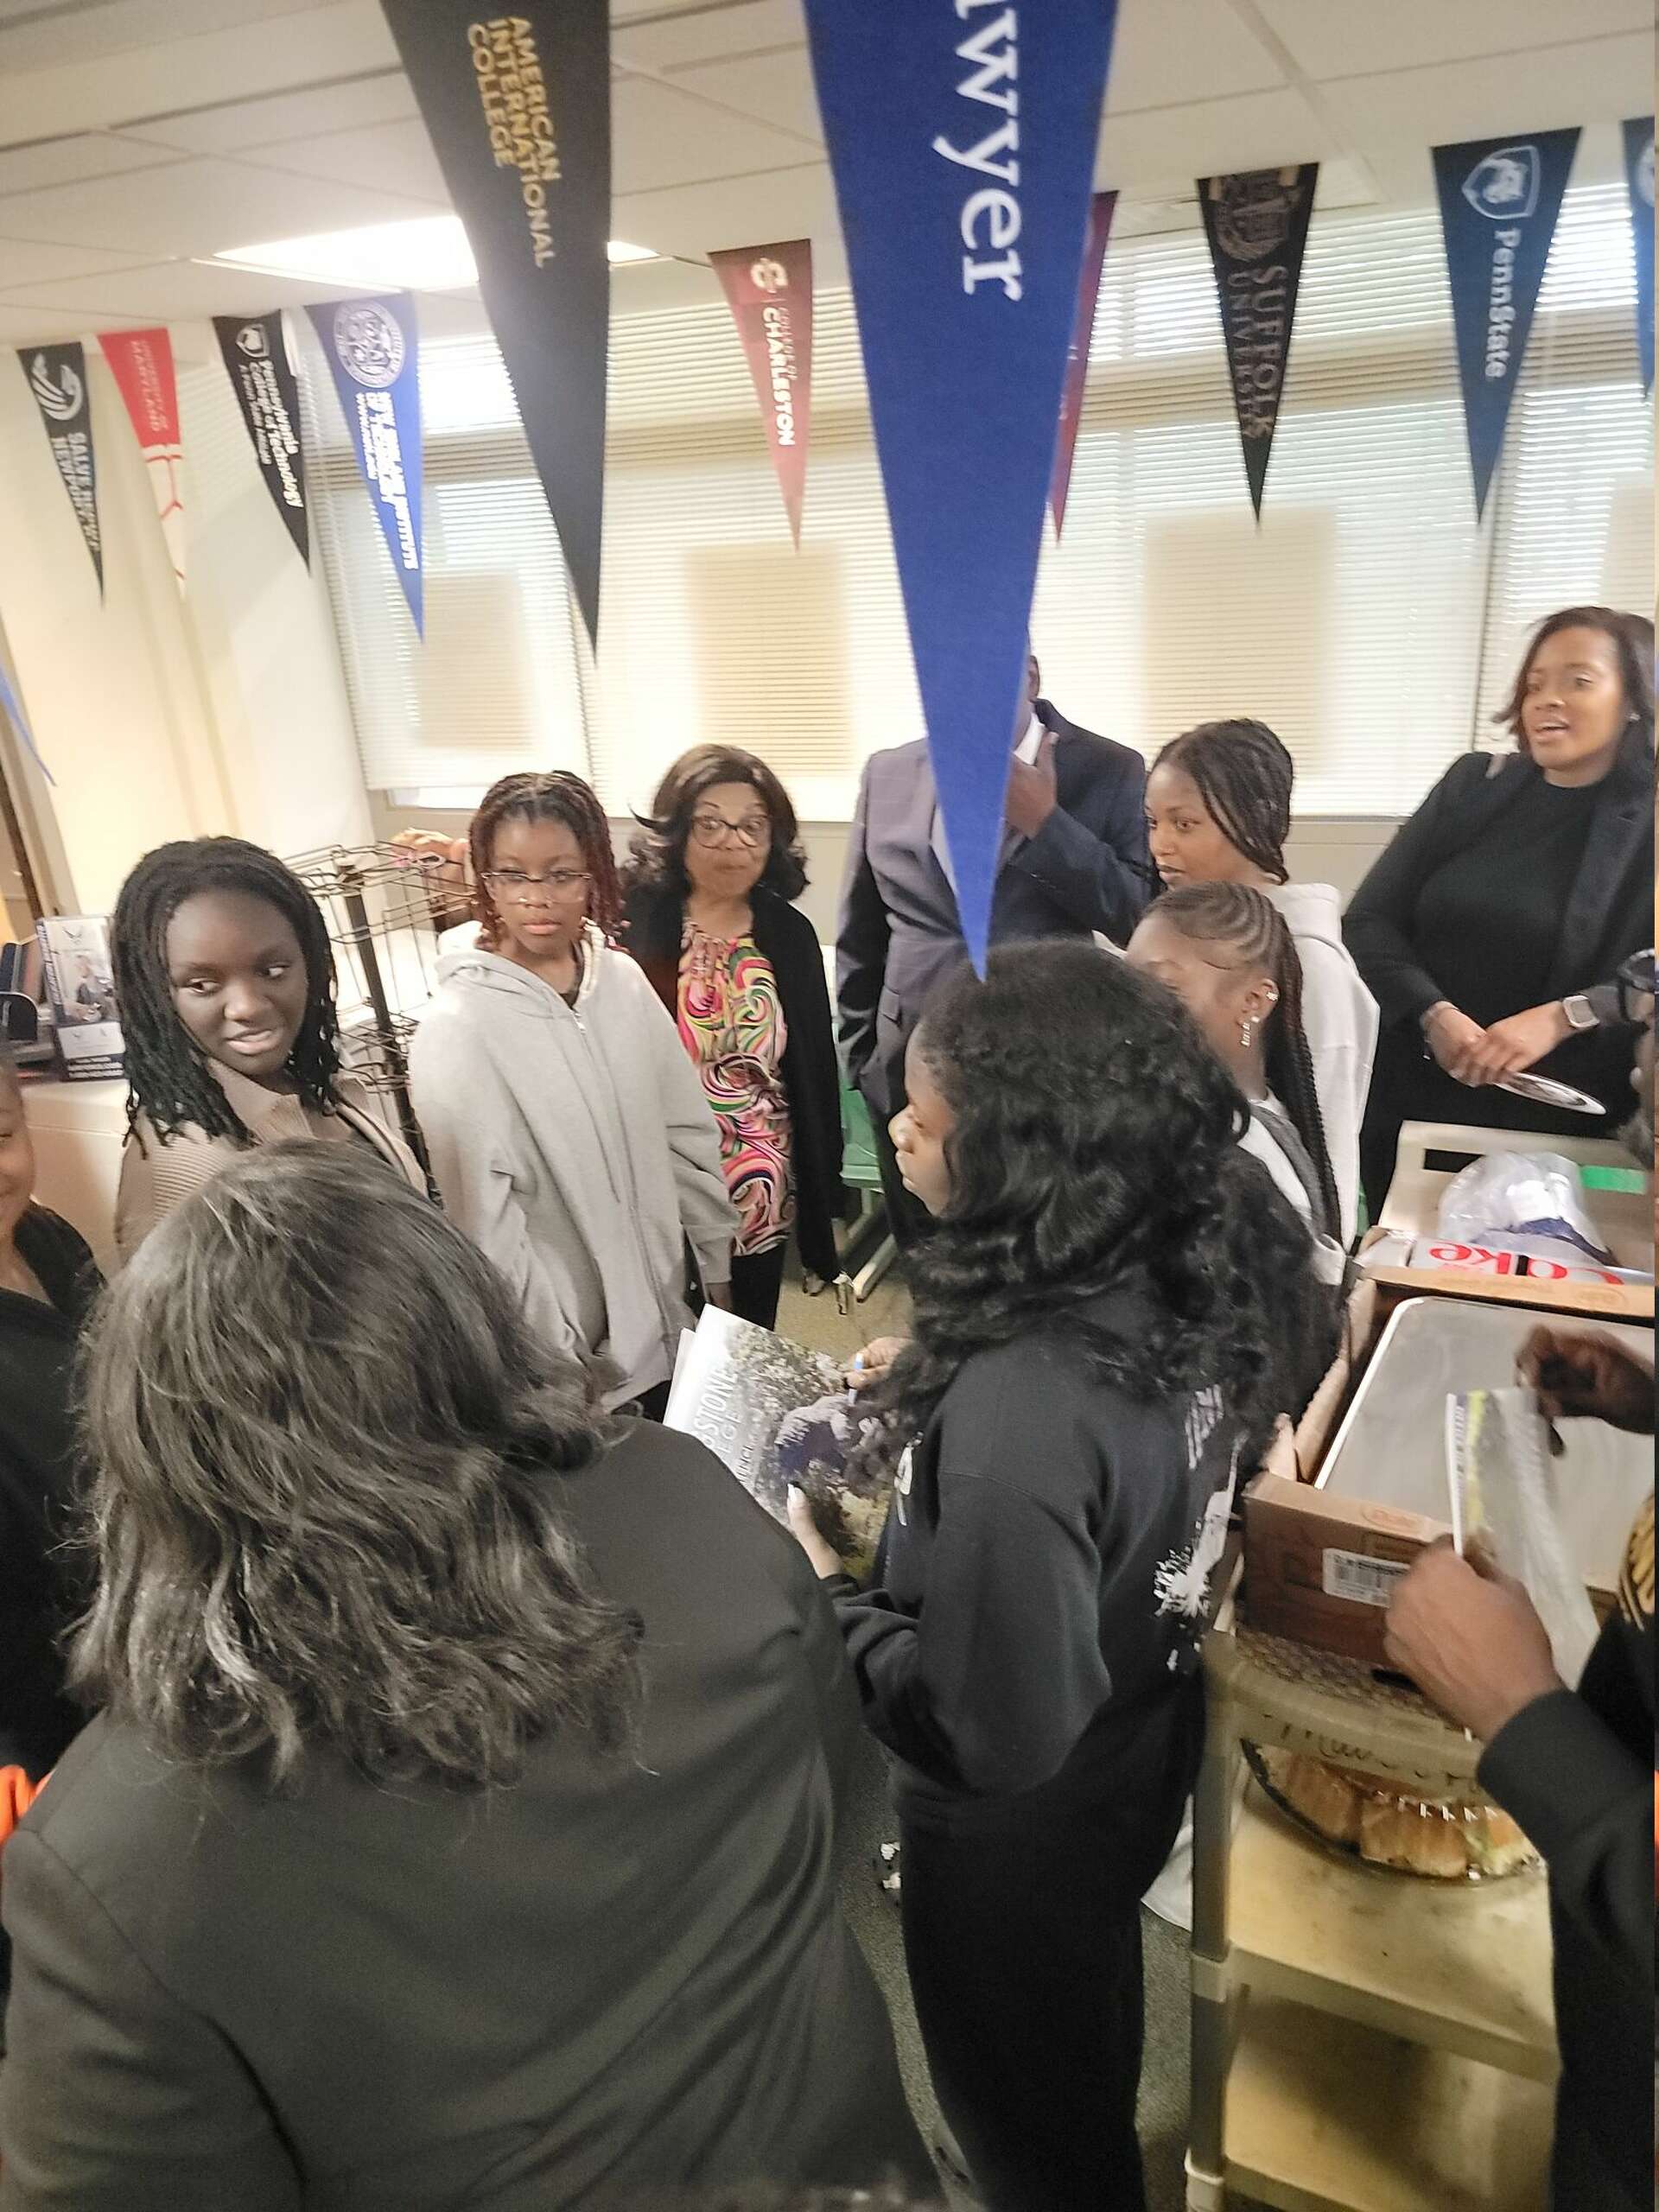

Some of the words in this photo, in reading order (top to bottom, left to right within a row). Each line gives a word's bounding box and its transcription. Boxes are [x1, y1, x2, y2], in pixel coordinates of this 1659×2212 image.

[468, 23, 516, 168] COLLEGE
[486, 19, 556, 269] INTERNATIONAL
[509, 16, 562, 180] AMERICAN
[931, 0, 1023, 302] wyer
[249, 361, 273, 414] College
[260, 359, 299, 455] Pennsylvania
[264, 414, 278, 429] of
[762, 307, 796, 446] CHARLESTON
[1253, 265, 1288, 438] SUFFOLK
[268, 430, 304, 508] Technology
